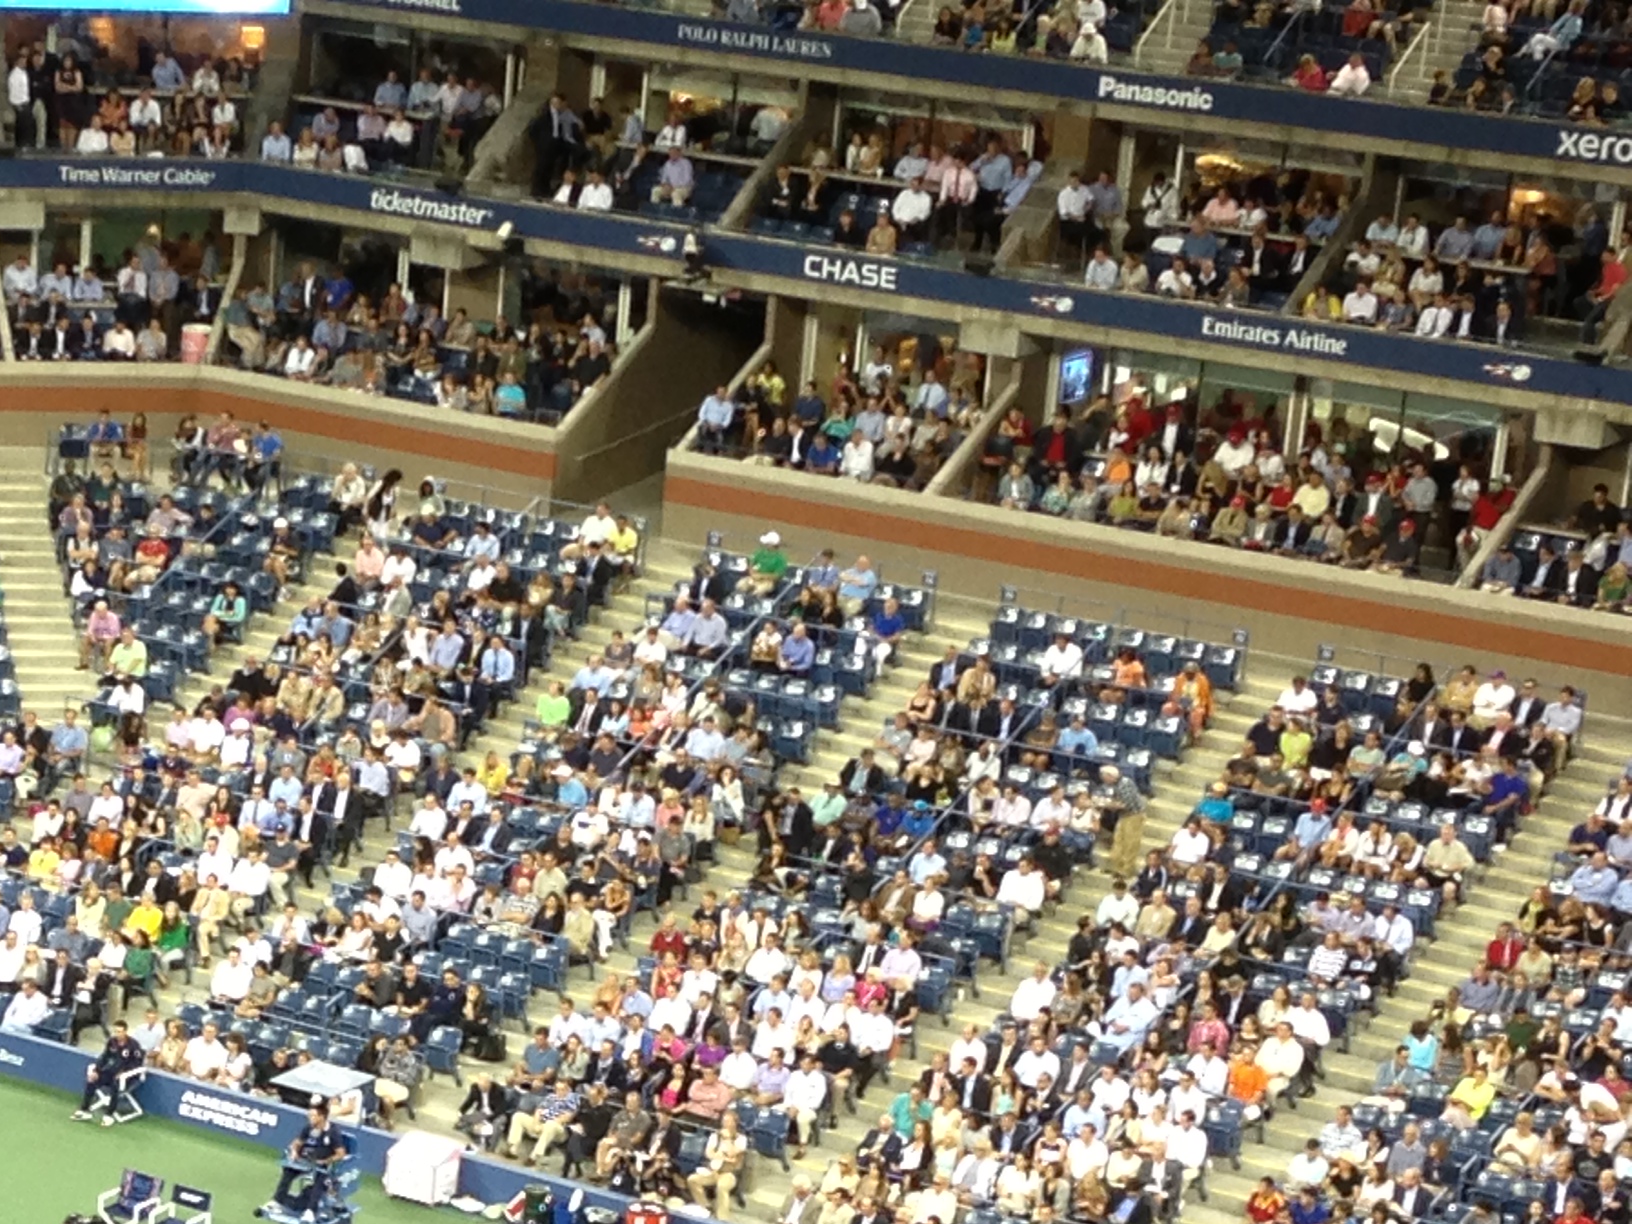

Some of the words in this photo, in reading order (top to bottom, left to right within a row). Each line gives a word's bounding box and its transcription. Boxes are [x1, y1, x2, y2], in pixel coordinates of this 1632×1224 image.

[678, 24, 718, 42] POLO
[721, 29, 769, 50] RALPH
[772, 36, 832, 57] LAUREN
[1098, 76, 1213, 110] Panasonic
[59, 165, 100, 183] Time
[101, 167, 160, 184] Warner
[371, 189, 487, 224] ticketmaster
[804, 255, 897, 290] CHASE
[1202, 316, 1280, 346] Emirates
[1284, 329, 1347, 355] Airline
[178, 1103, 260, 1135] EXPRESS
[181, 1090, 278, 1127] AMERICAN
